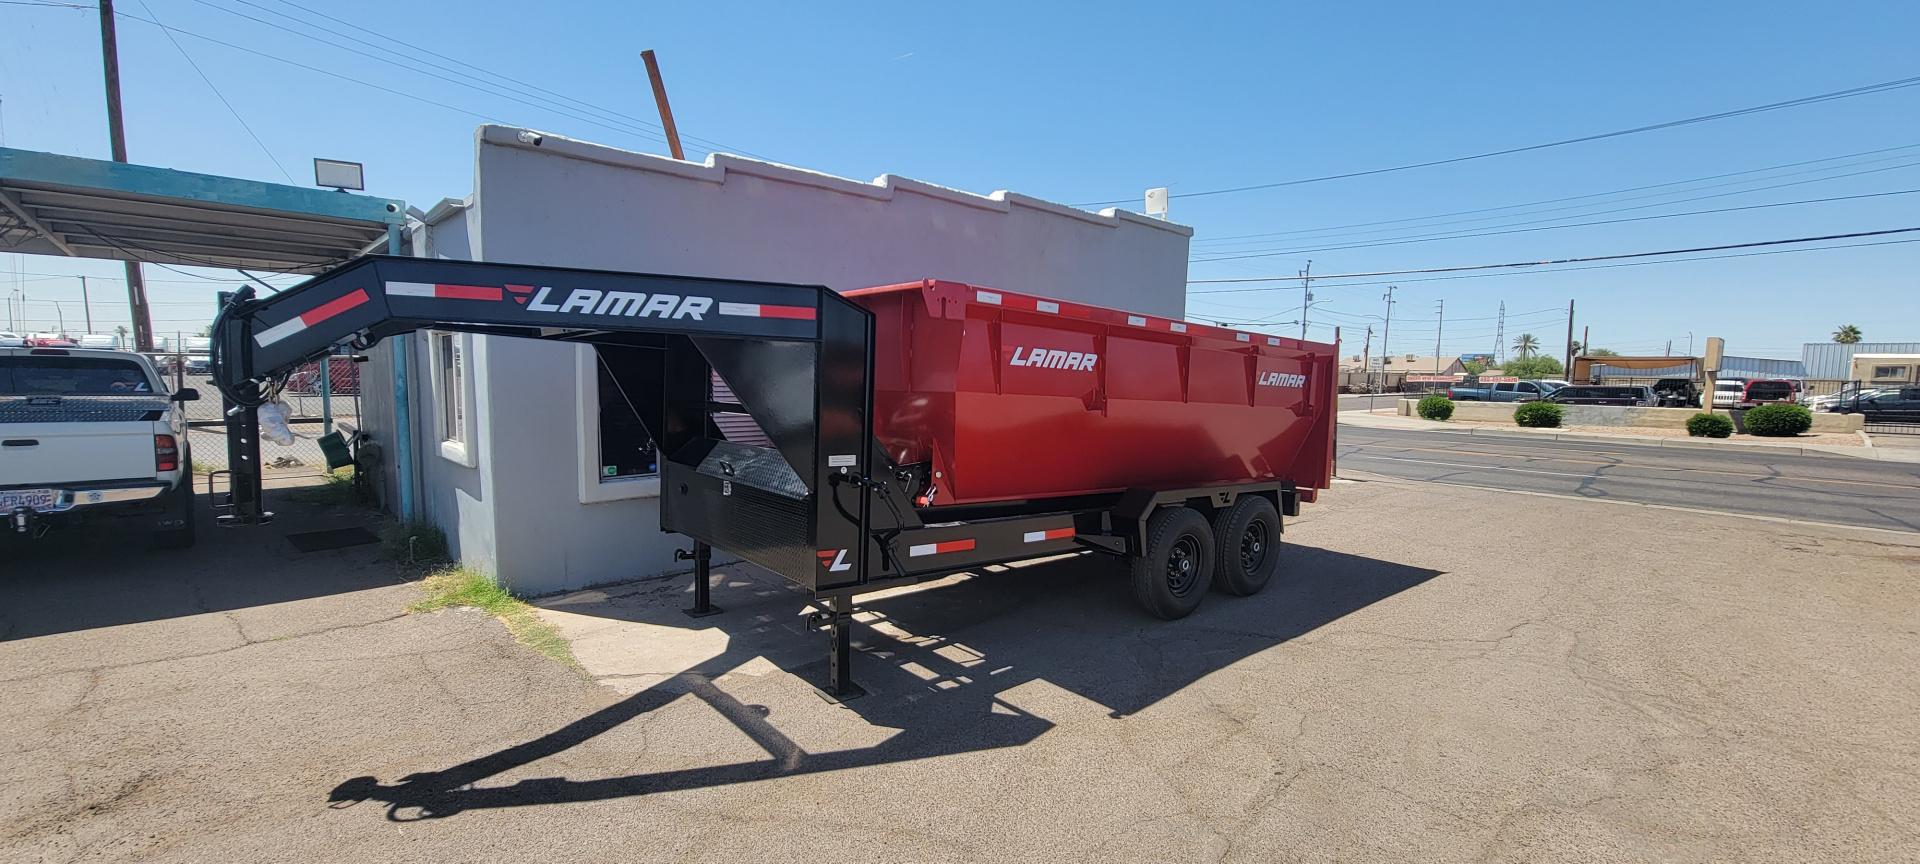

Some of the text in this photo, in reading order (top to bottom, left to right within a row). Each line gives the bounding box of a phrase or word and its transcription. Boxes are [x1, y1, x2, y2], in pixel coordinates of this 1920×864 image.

[526, 287, 713, 320] LAMAR
[1009, 346, 1098, 372] LAMAR
[1258, 371, 1306, 388] LAMAR
